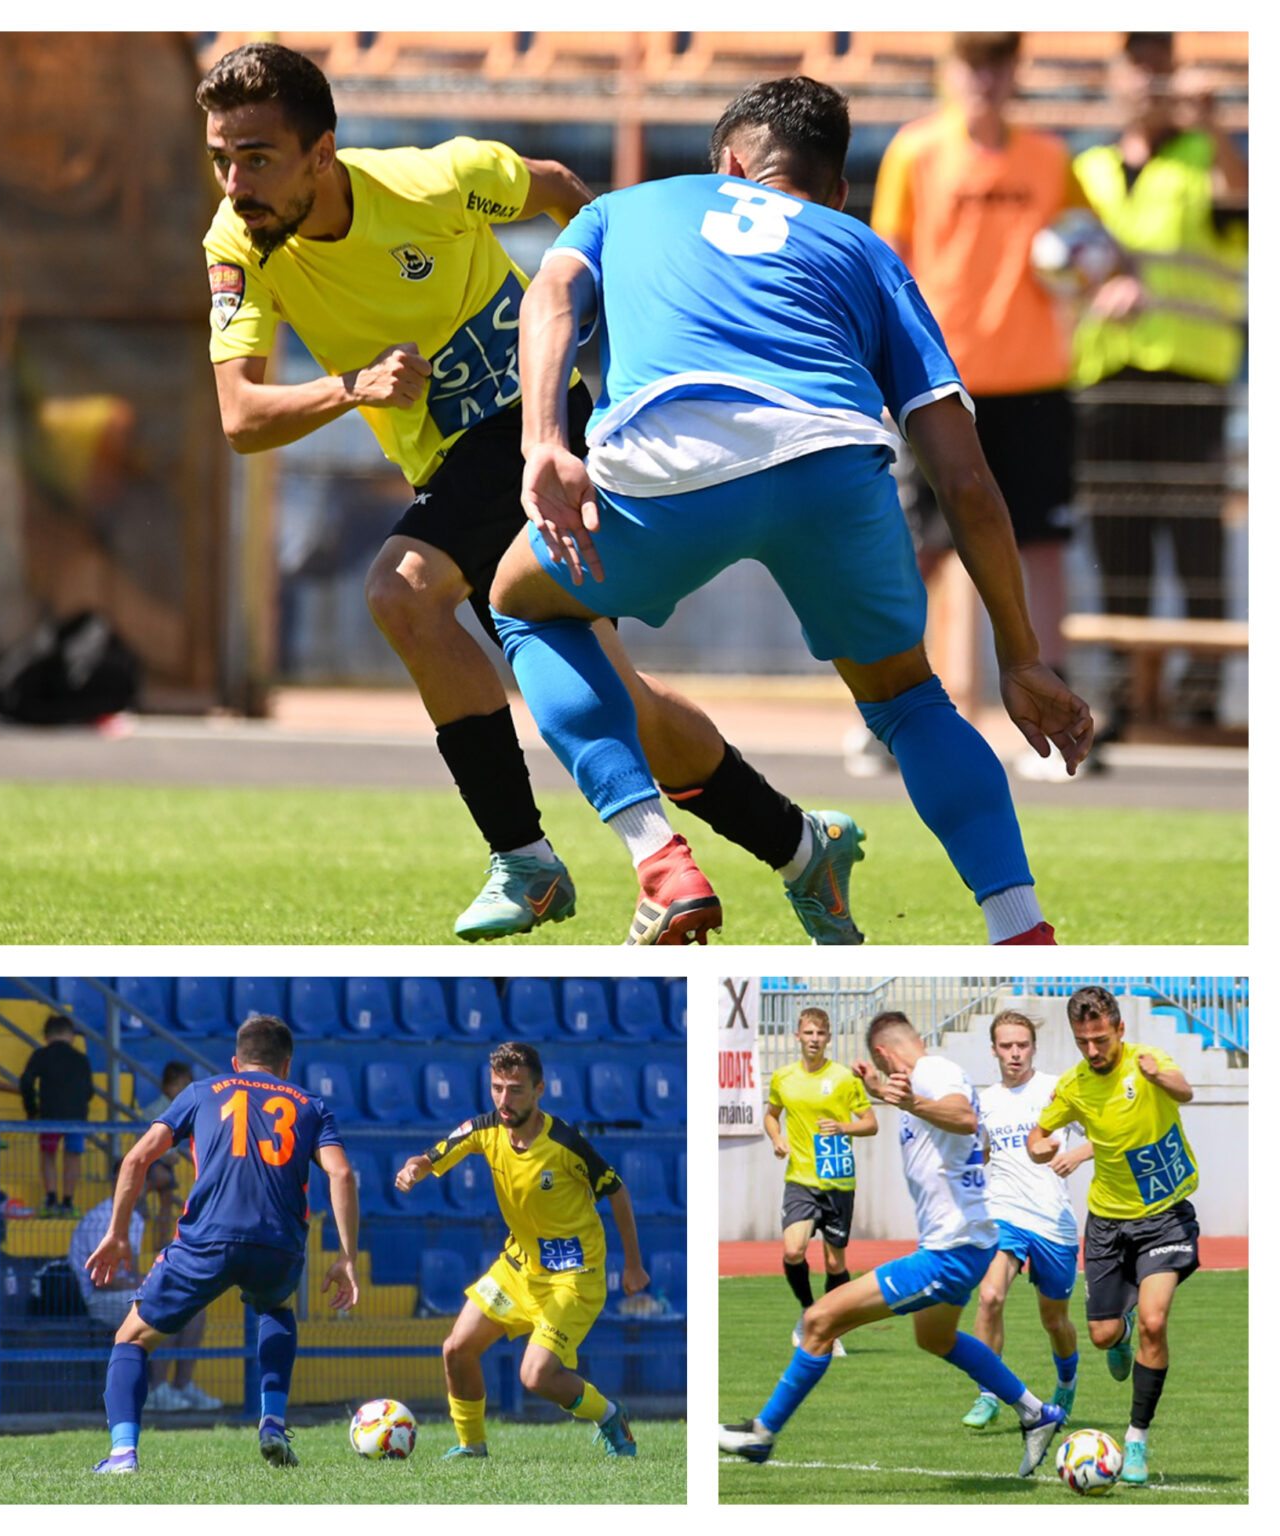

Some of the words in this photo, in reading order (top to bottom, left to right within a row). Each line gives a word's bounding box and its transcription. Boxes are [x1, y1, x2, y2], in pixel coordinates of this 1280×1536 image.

[700, 181, 804, 257] 3
[723, 977, 749, 1029] X
[221, 1089, 298, 1167] 13
